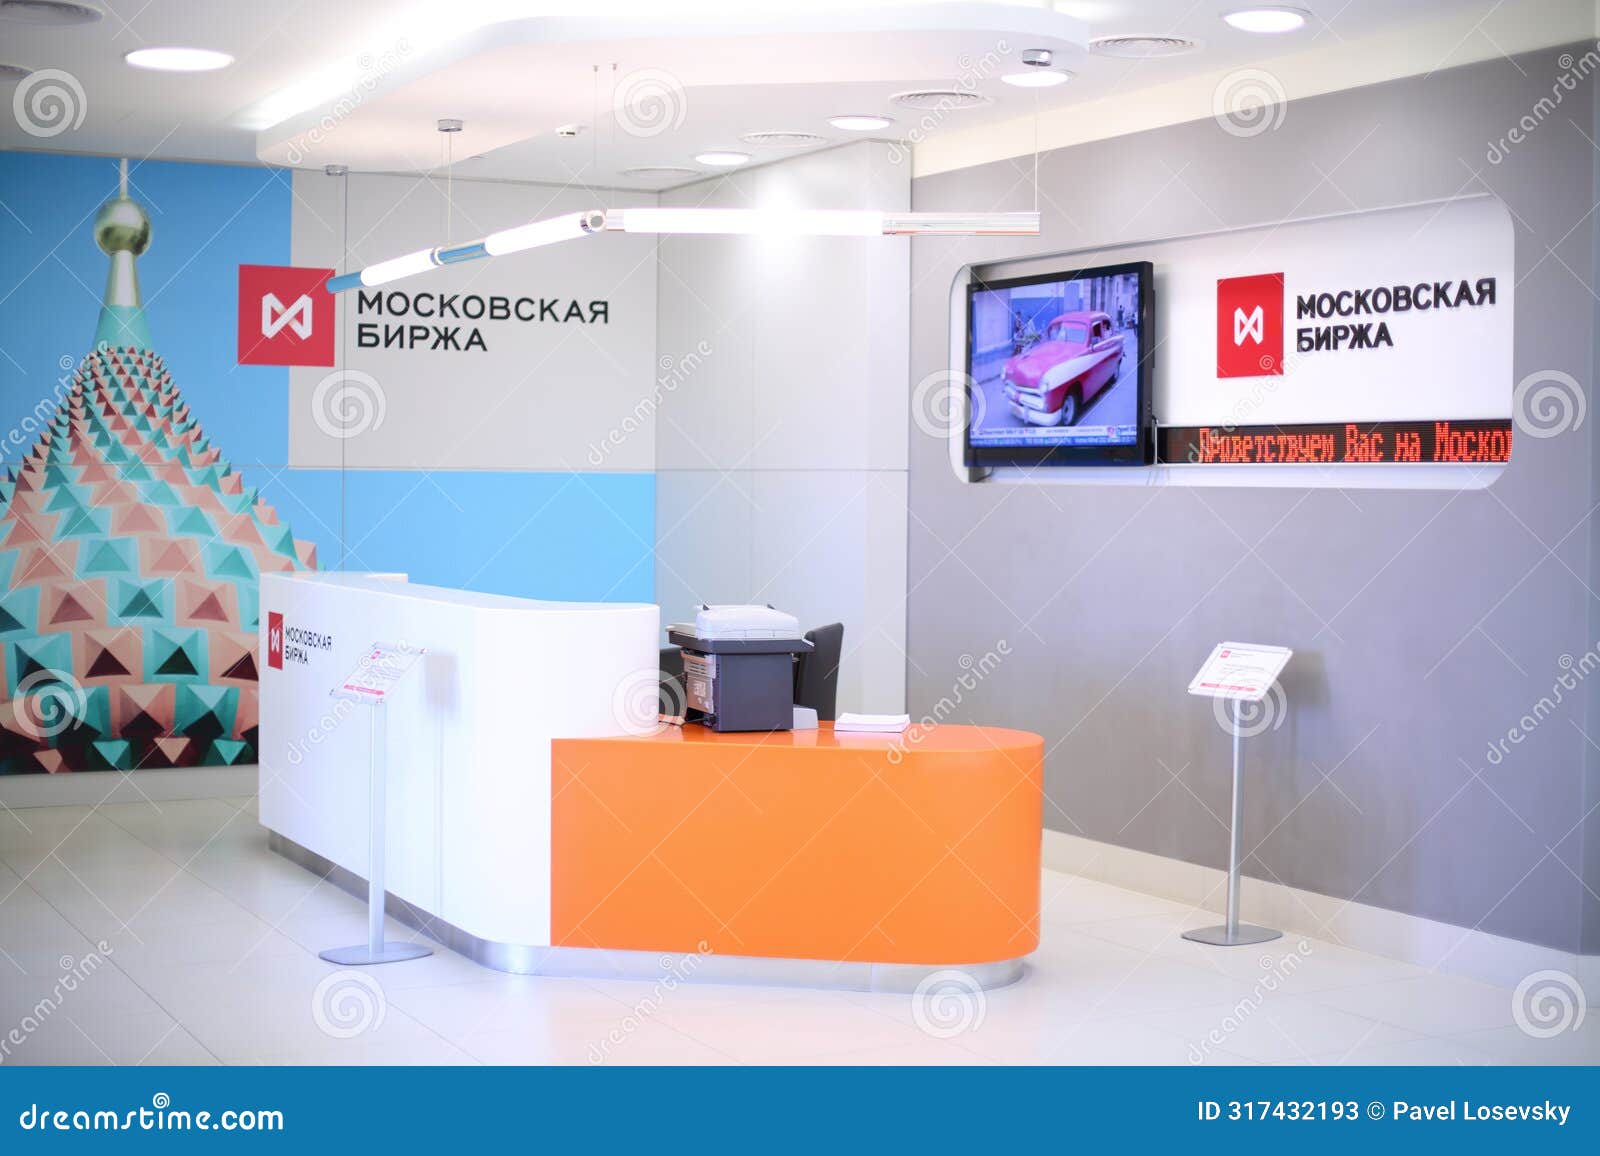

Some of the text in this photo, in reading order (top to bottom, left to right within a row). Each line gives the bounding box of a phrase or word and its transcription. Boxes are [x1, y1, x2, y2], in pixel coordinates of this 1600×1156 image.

[358, 290, 609, 324] МОСКОВСКАЯ
[1297, 277, 1496, 320] МОСКОВСКАЯ
[358, 323, 488, 352] БИРЖА
[1297, 322, 1394, 353] БИРЖА
[1199, 427, 1335, 463] Приветствуем
[1345, 424, 1384, 462] Вас
[1395, 432, 1421, 462] на
[285, 627, 332, 651] МОСКОВСКАЯ
[285, 645, 309, 665] БИРЖА
